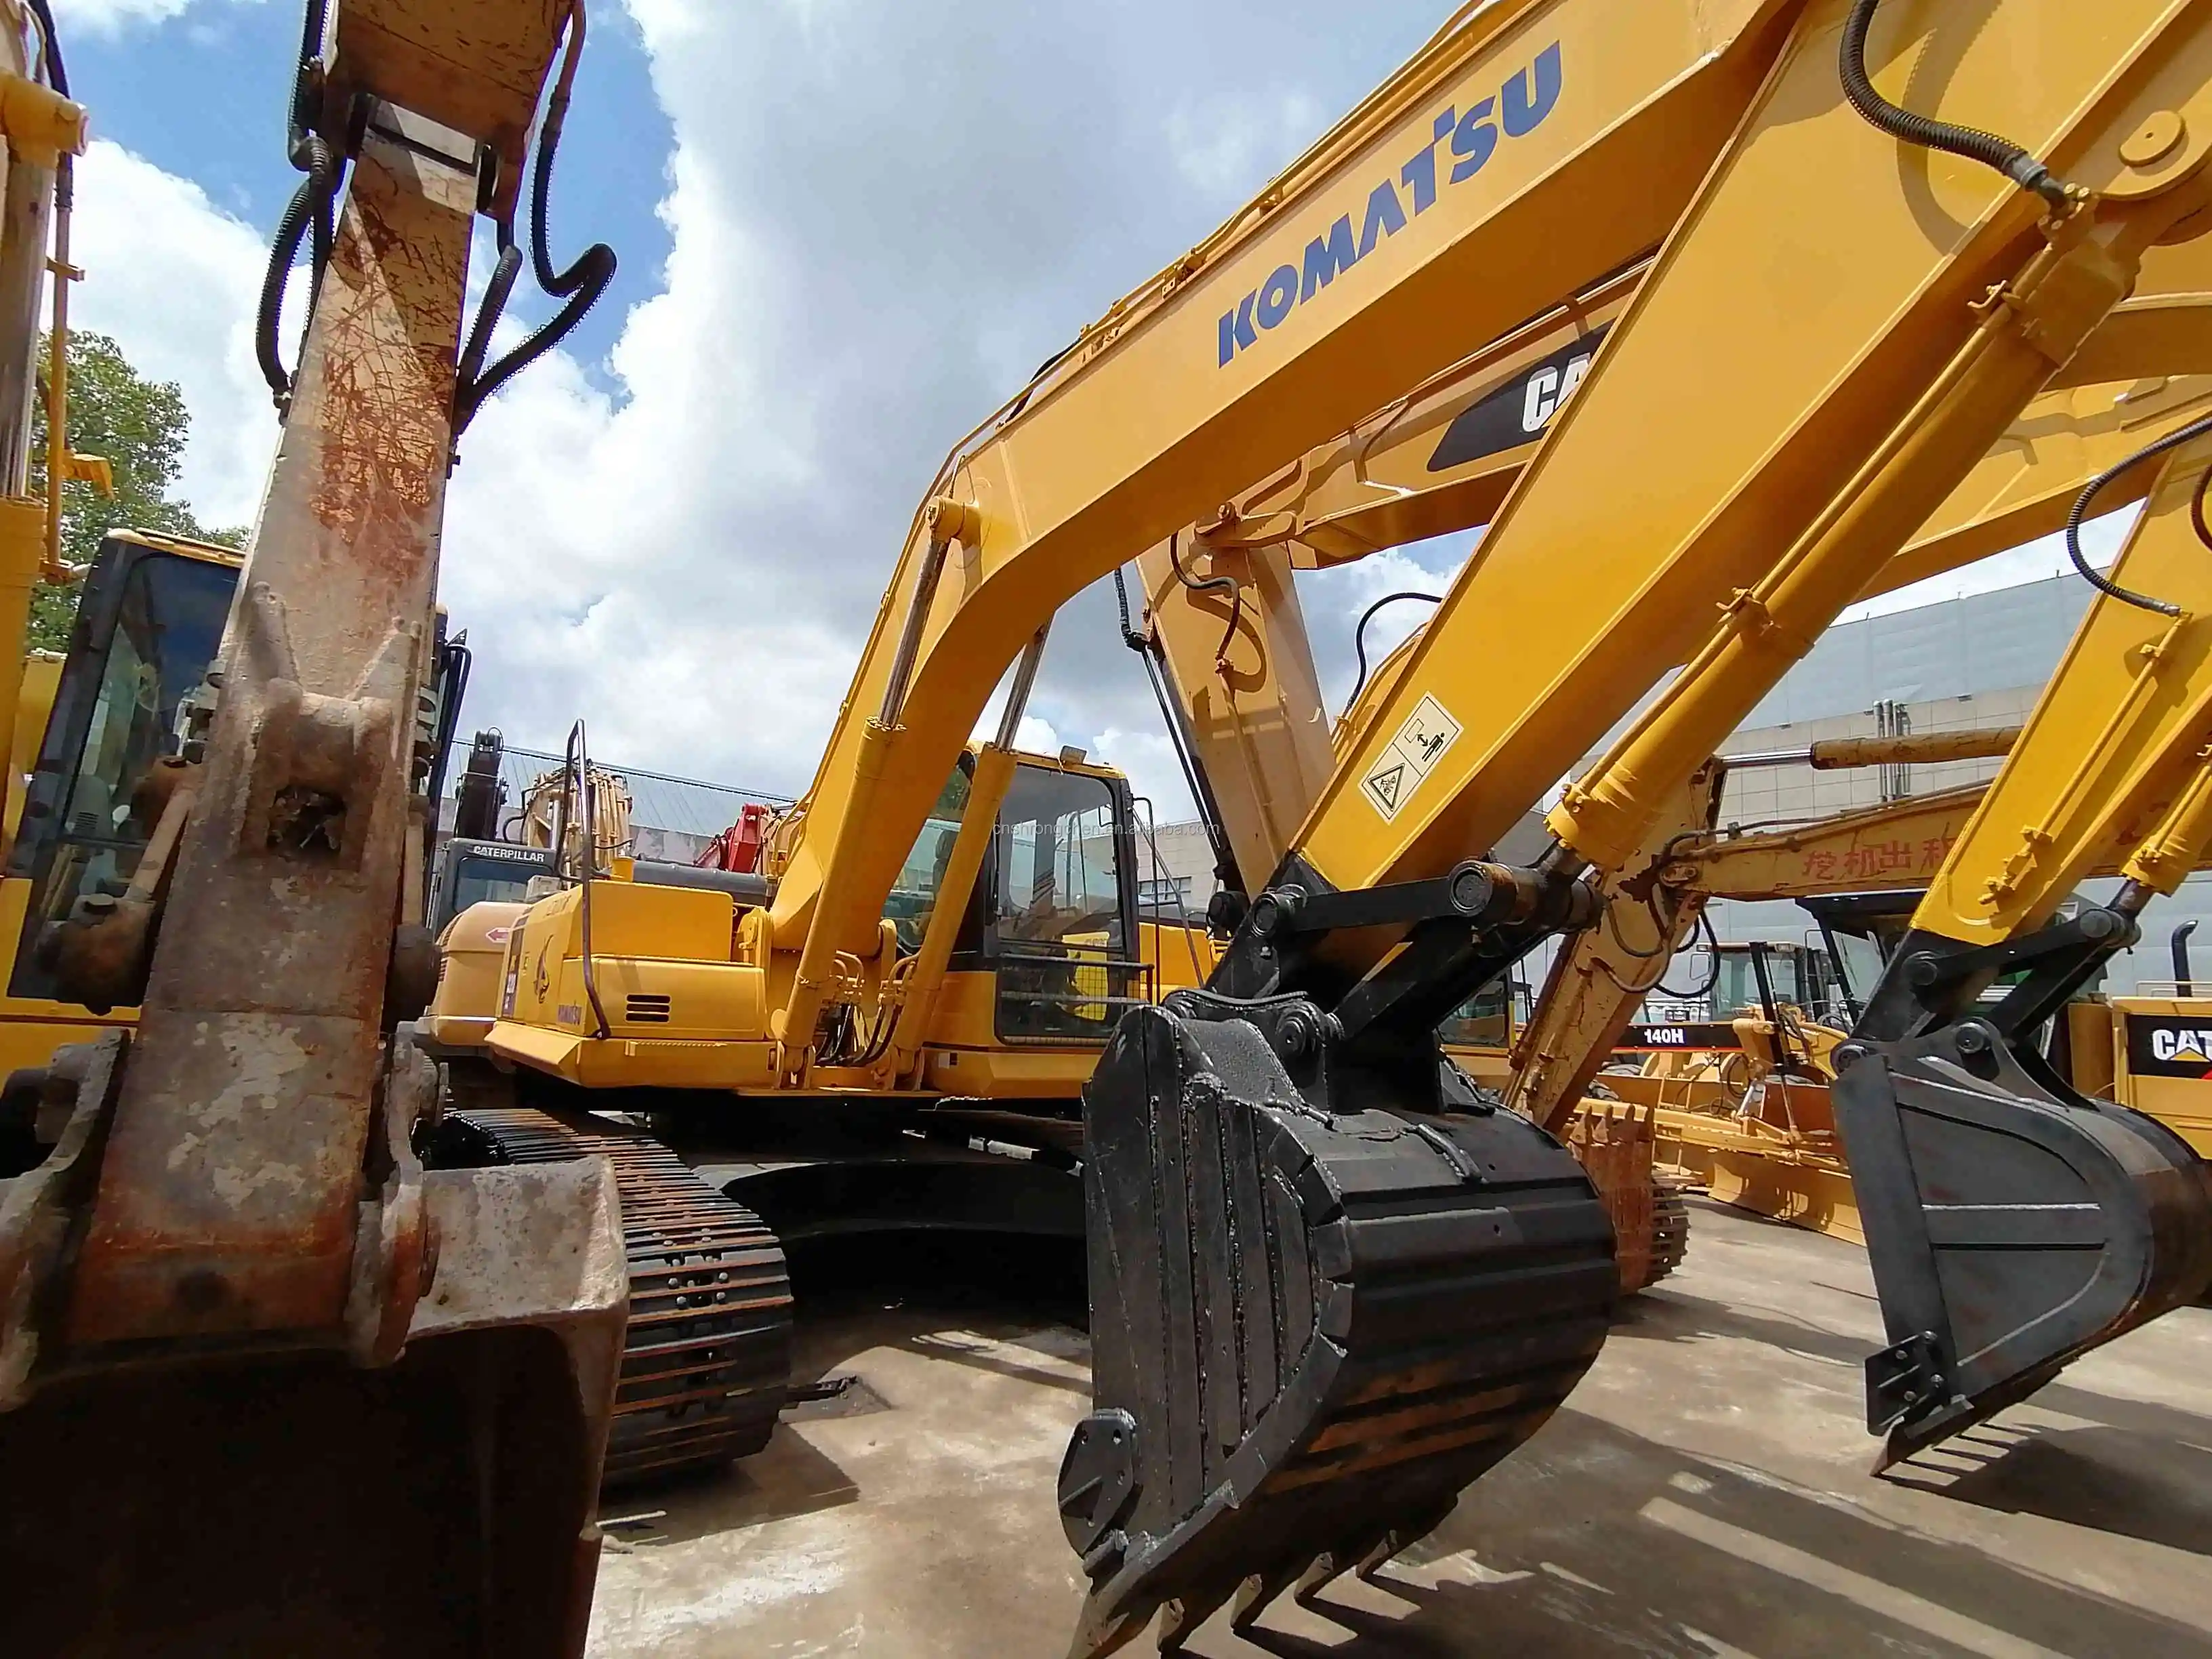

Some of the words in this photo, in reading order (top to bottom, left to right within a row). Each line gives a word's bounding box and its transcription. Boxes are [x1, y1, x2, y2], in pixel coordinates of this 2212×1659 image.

[1218, 39, 1563, 369] KOMATSU
[473, 845, 545, 863] CATERPILLAR
[1644, 1028, 1685, 1044] 140H
[2152, 1029, 2212, 1061] CAT
